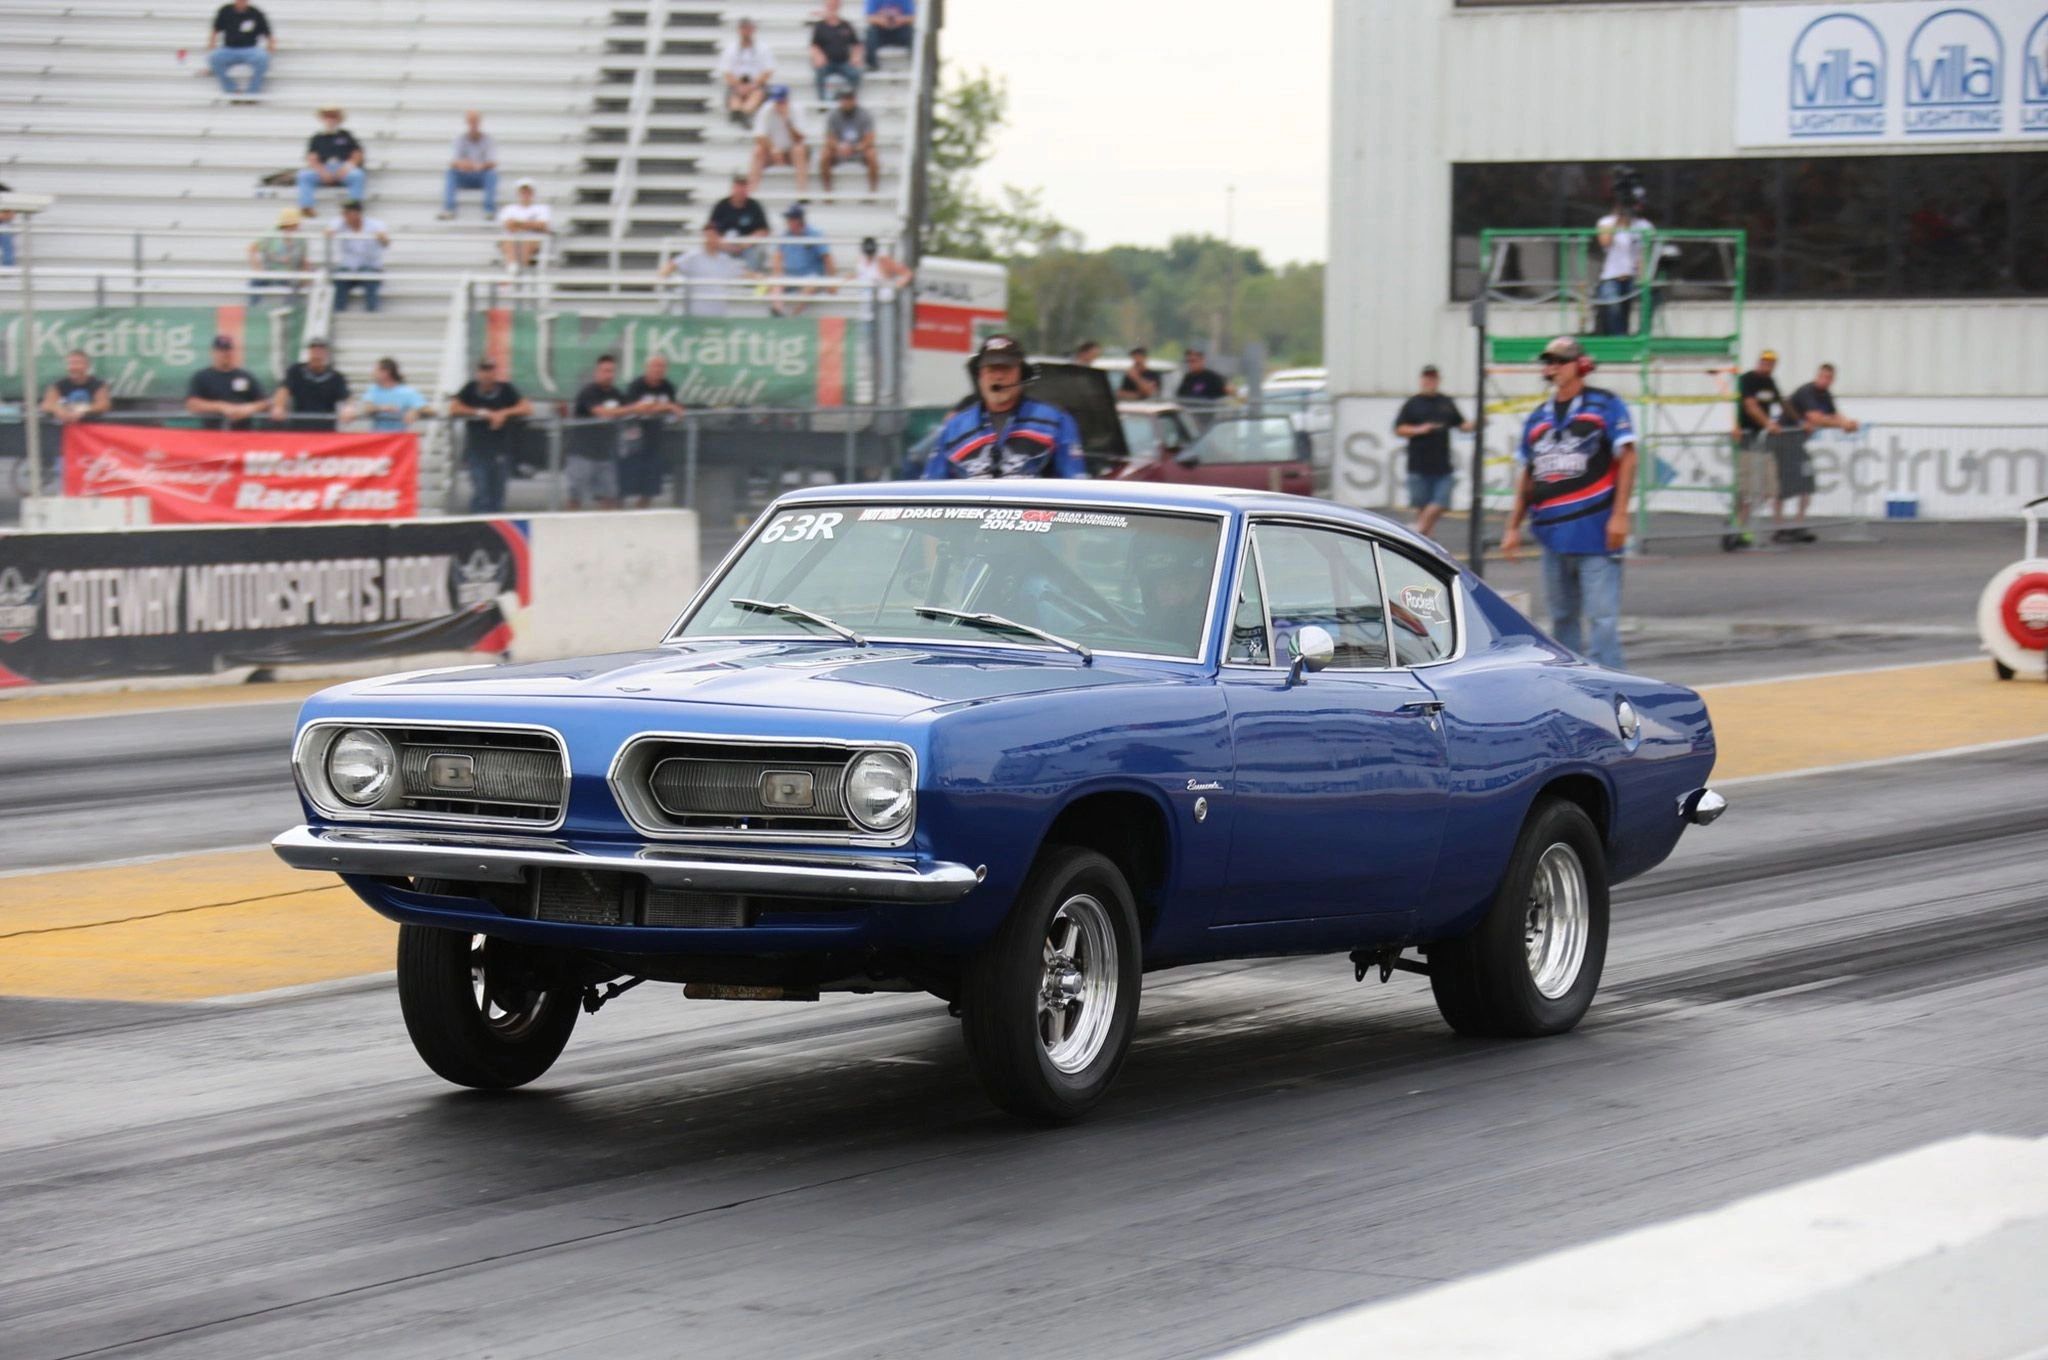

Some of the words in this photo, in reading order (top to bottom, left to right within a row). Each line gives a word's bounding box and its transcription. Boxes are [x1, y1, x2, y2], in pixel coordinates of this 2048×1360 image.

[1790, 112, 1886, 130] LIGHTING
[1905, 109, 2001, 127] LIGHTING
[242, 450, 391, 478] Welcome
[235, 483, 318, 510] Race
[320, 483, 399, 511] Fans
[761, 512, 844, 543] 63R
[901, 508, 943, 520] DRAG
[943, 508, 986, 521] WEEK
[987, 509, 1024, 521] 2013
[47, 566, 183, 640] GATEWAY
[185, 557, 383, 633] MOTORSPORTS
[385, 554, 456, 622] PARK
